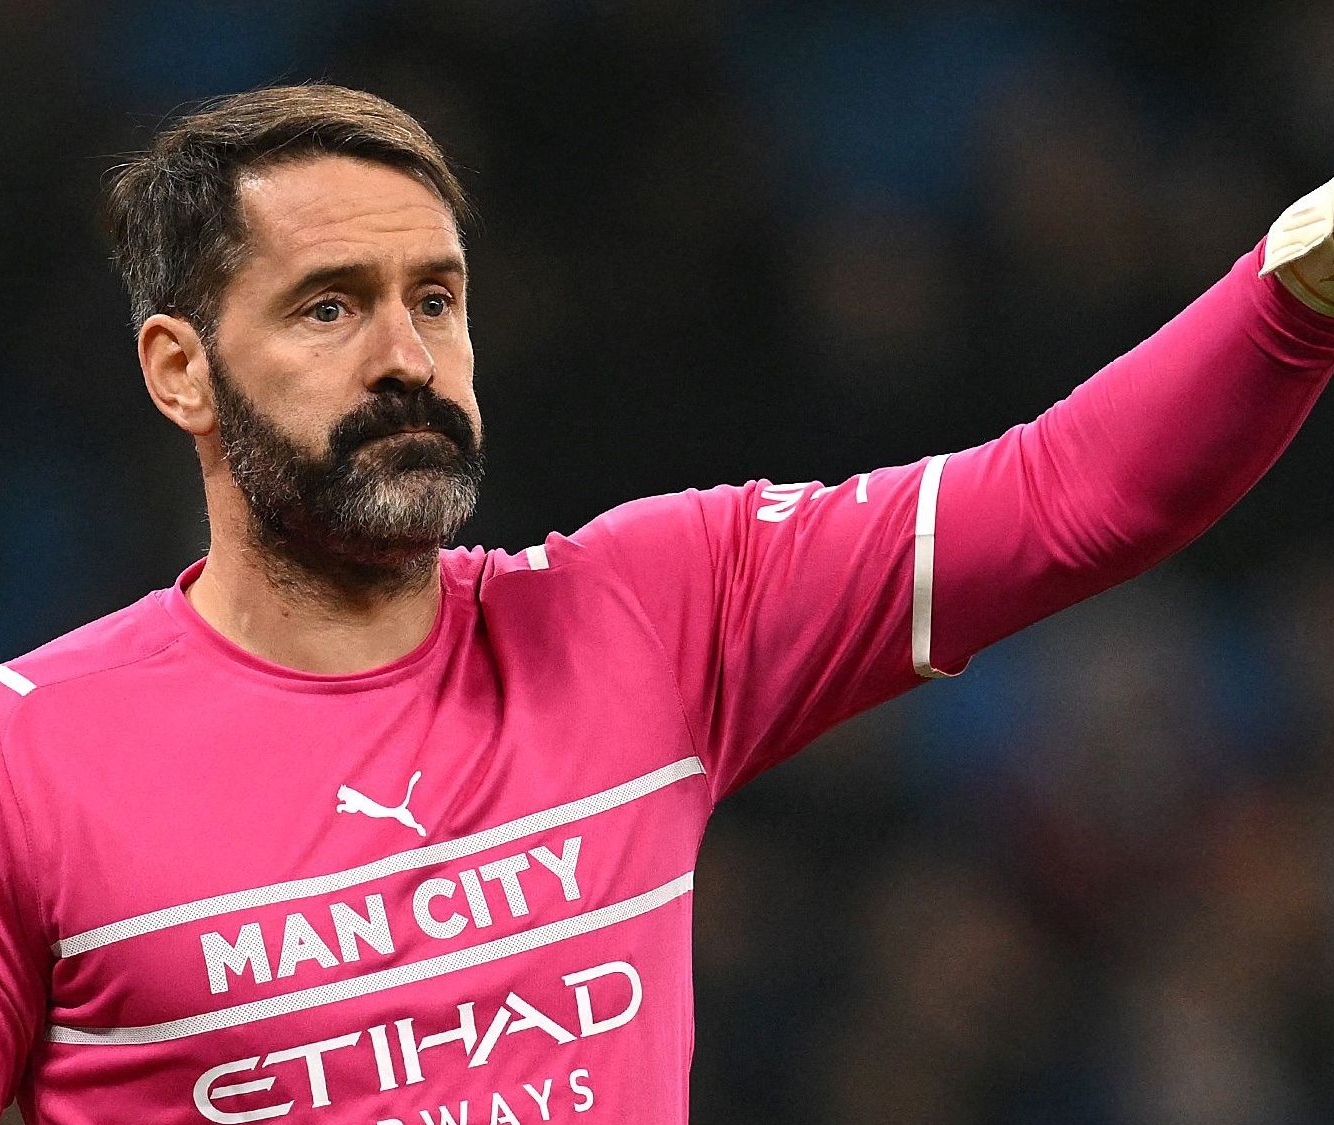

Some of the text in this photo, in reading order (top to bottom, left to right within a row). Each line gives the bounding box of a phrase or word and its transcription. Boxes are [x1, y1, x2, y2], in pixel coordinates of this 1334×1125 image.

[199, 835, 585, 995] MAN CITY
[192, 960, 644, 1125] ETIHAD
